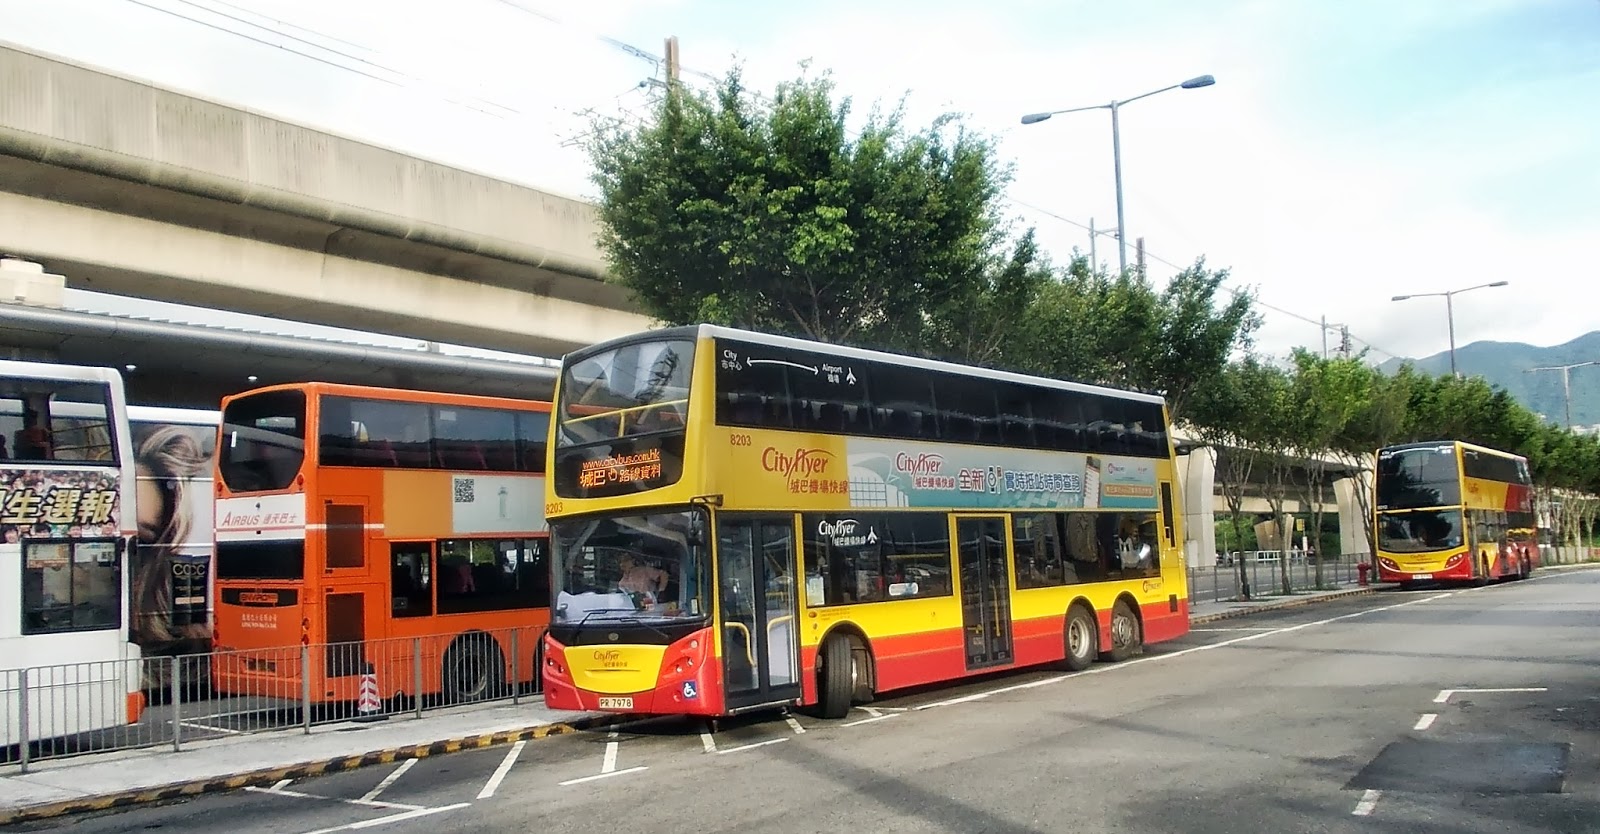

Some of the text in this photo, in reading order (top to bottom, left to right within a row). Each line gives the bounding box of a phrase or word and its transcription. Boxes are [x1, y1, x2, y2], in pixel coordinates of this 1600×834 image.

[723, 349, 738, 361] City
[721, 360, 743, 371] 市中心
[822, 363, 843, 374] Airport
[730, 434, 752, 446] 8203
[582, 448, 661, 470] www.citybus.com.hk
[762, 447, 836, 479] Cityflyer
[896, 452, 944, 476] Cityflyer
[580, 463, 661, 488] 城巴 路線資料
[958, 468, 985, 493] 全新
[790, 478, 849, 494] 城巴機場快線
[0, 488, 117, 525] 生選報
[545, 502, 564, 514] 8203
[818, 519, 859, 538] Cityflyer
[600, 698, 632, 707] PR 7978
